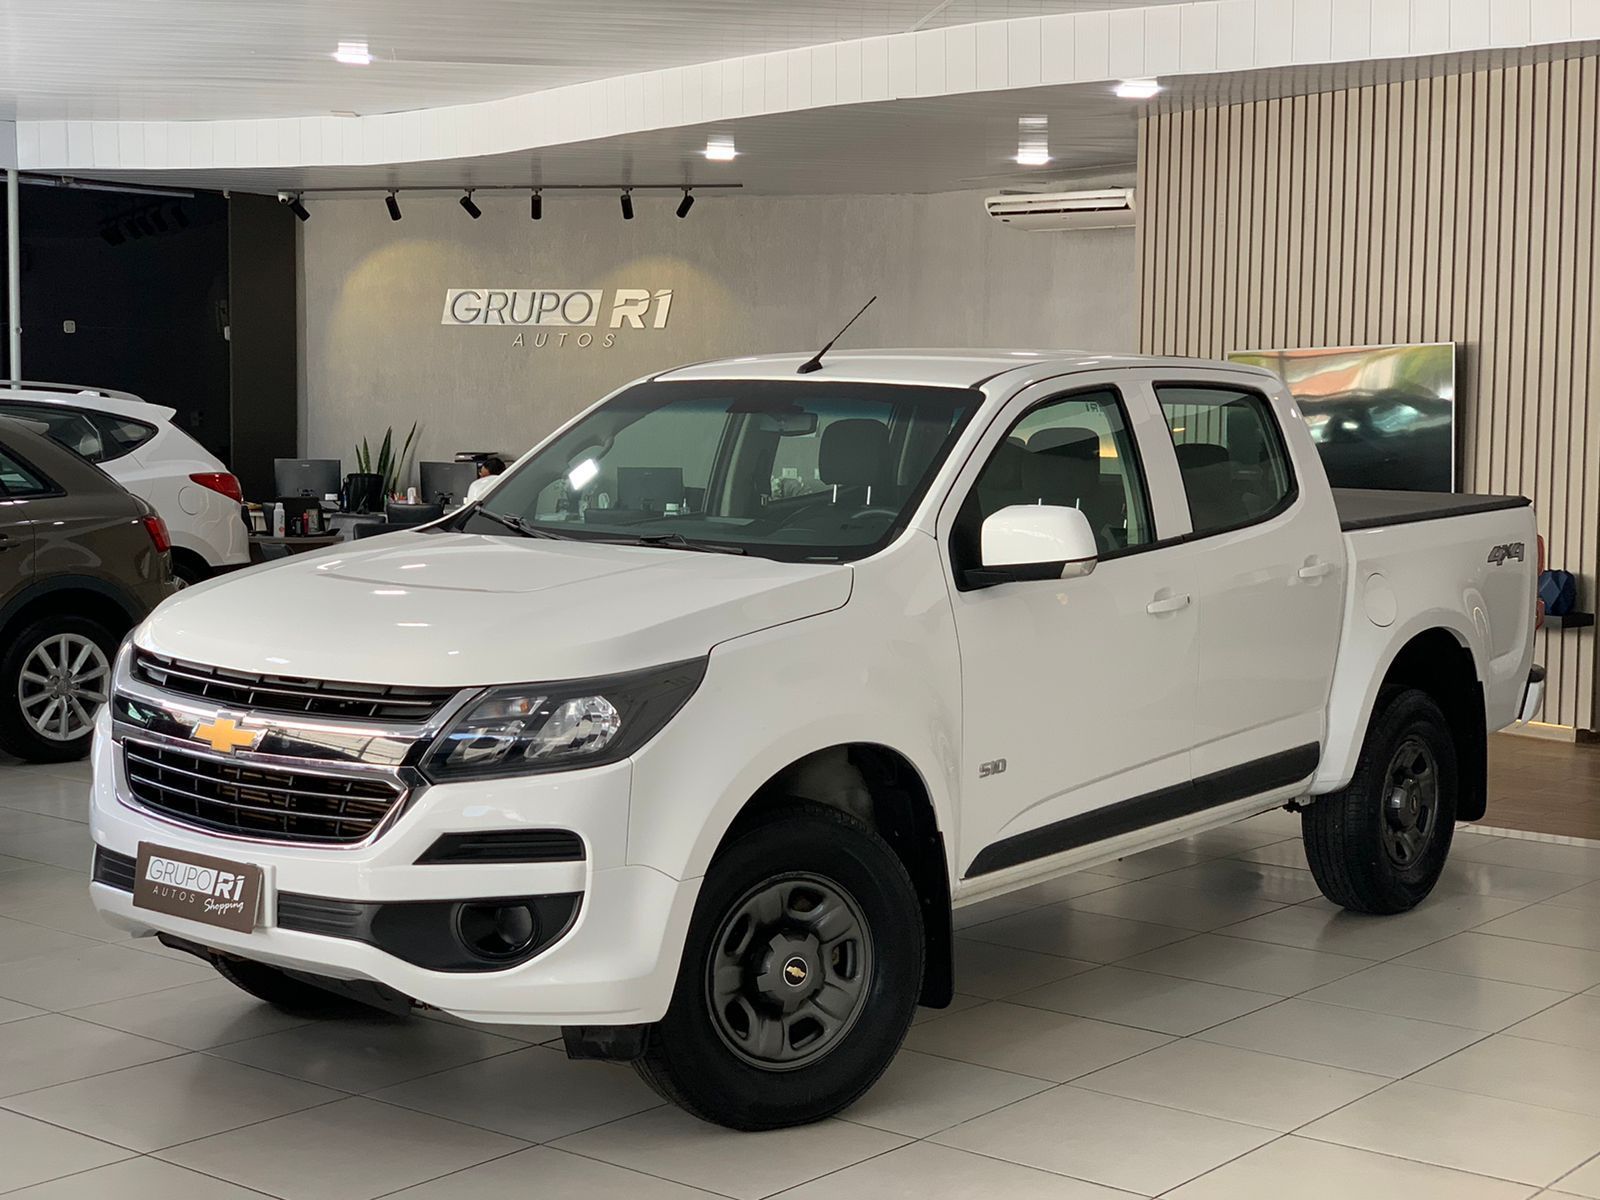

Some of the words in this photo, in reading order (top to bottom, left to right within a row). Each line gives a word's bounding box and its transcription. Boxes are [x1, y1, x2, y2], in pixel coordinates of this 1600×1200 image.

[450, 290, 594, 325] GRUPO
[609, 288, 674, 329] R1
[511, 332, 617, 349] AUTOS
[979, 758, 1007, 779] S10
[149, 858, 213, 891] GRUPO
[214, 871, 246, 901] R1
[152, 885, 196, 904] AUTOS
[203, 897, 245, 915] Shopping
